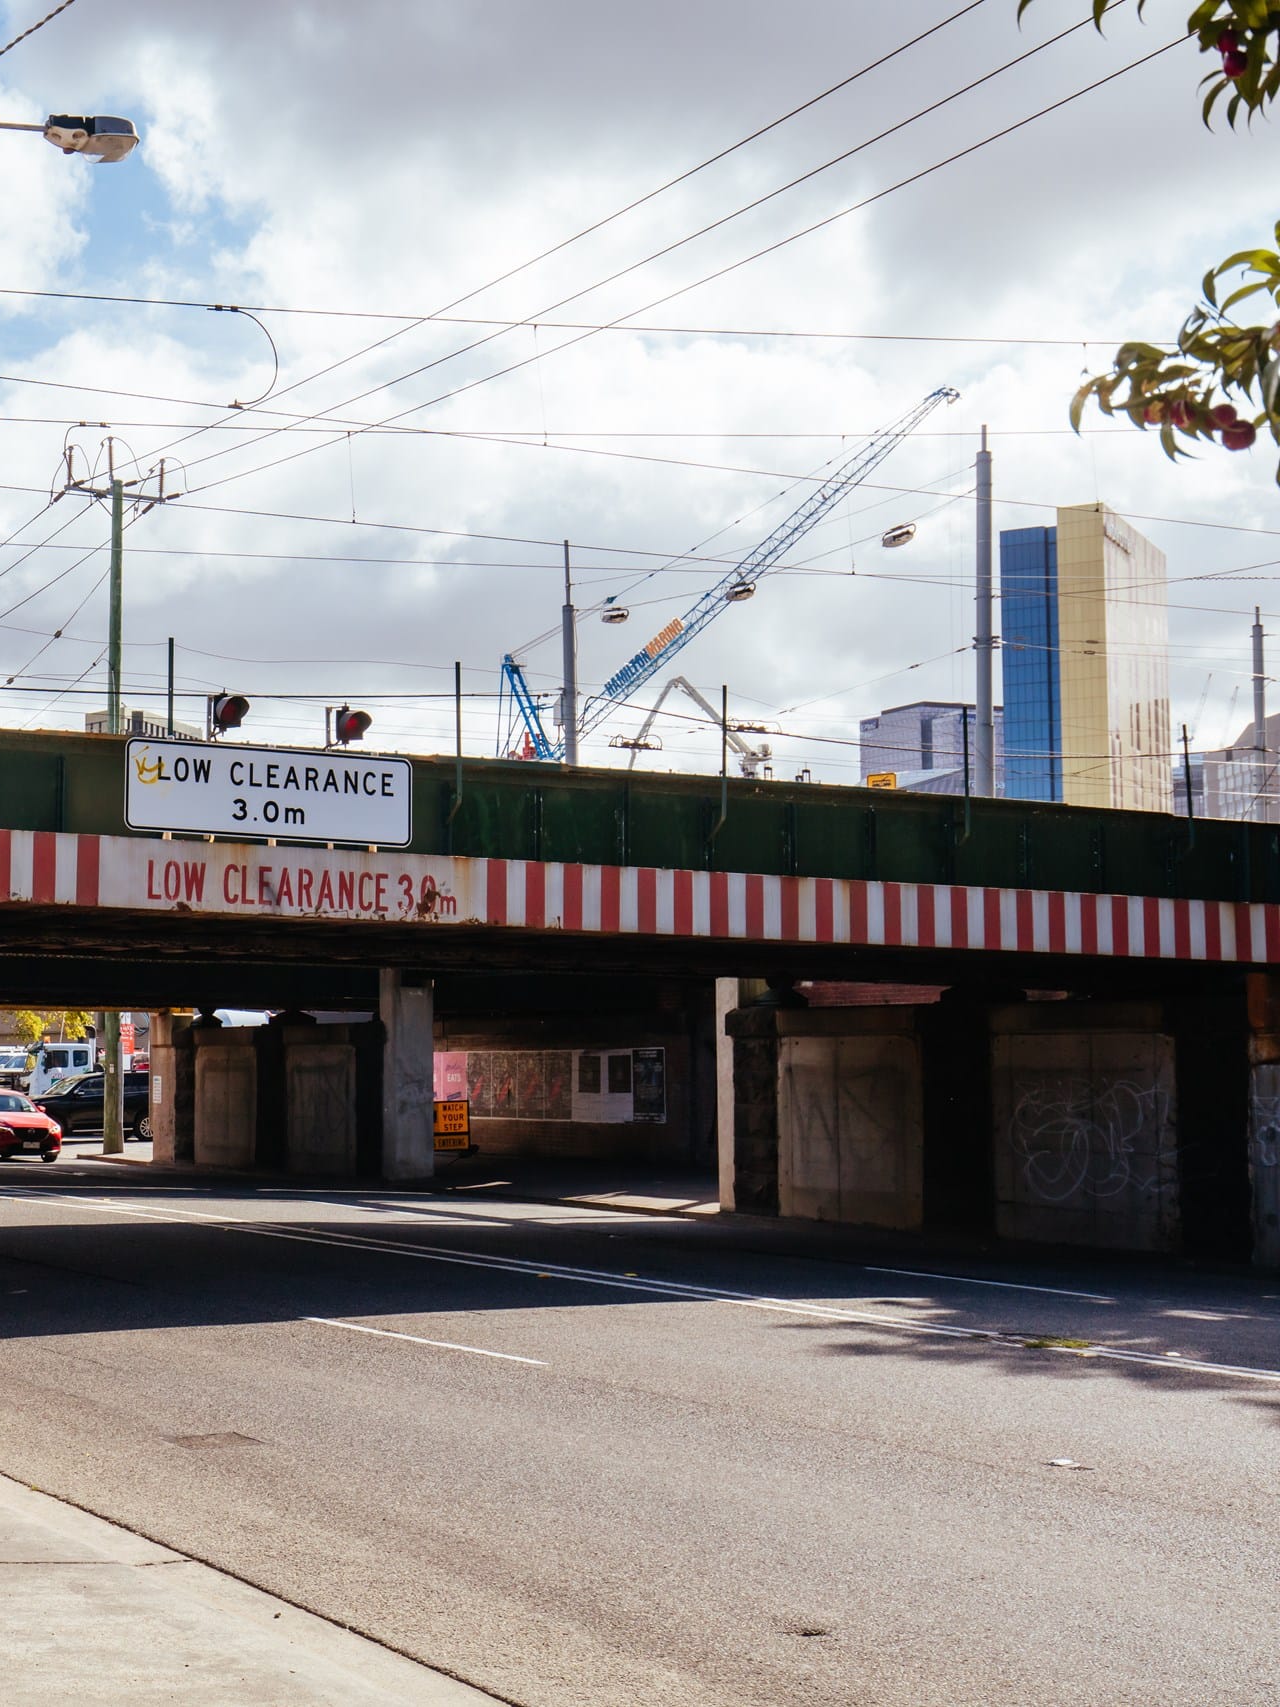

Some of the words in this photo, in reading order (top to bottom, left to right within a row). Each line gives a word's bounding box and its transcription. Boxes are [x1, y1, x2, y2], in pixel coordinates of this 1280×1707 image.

[605, 648, 651, 697] HAMILTON
[157, 756, 212, 784] LOW
[230, 761, 395, 797] CLEARANCE
[232, 798, 305, 825] 3.0m
[147, 859, 207, 902] LOW
[223, 863, 389, 912] CLEARANCE
[442, 1103, 464, 1112] WATCH
[442, 1113, 464, 1121] YOUR
[443, 1123, 464, 1131] STEP
